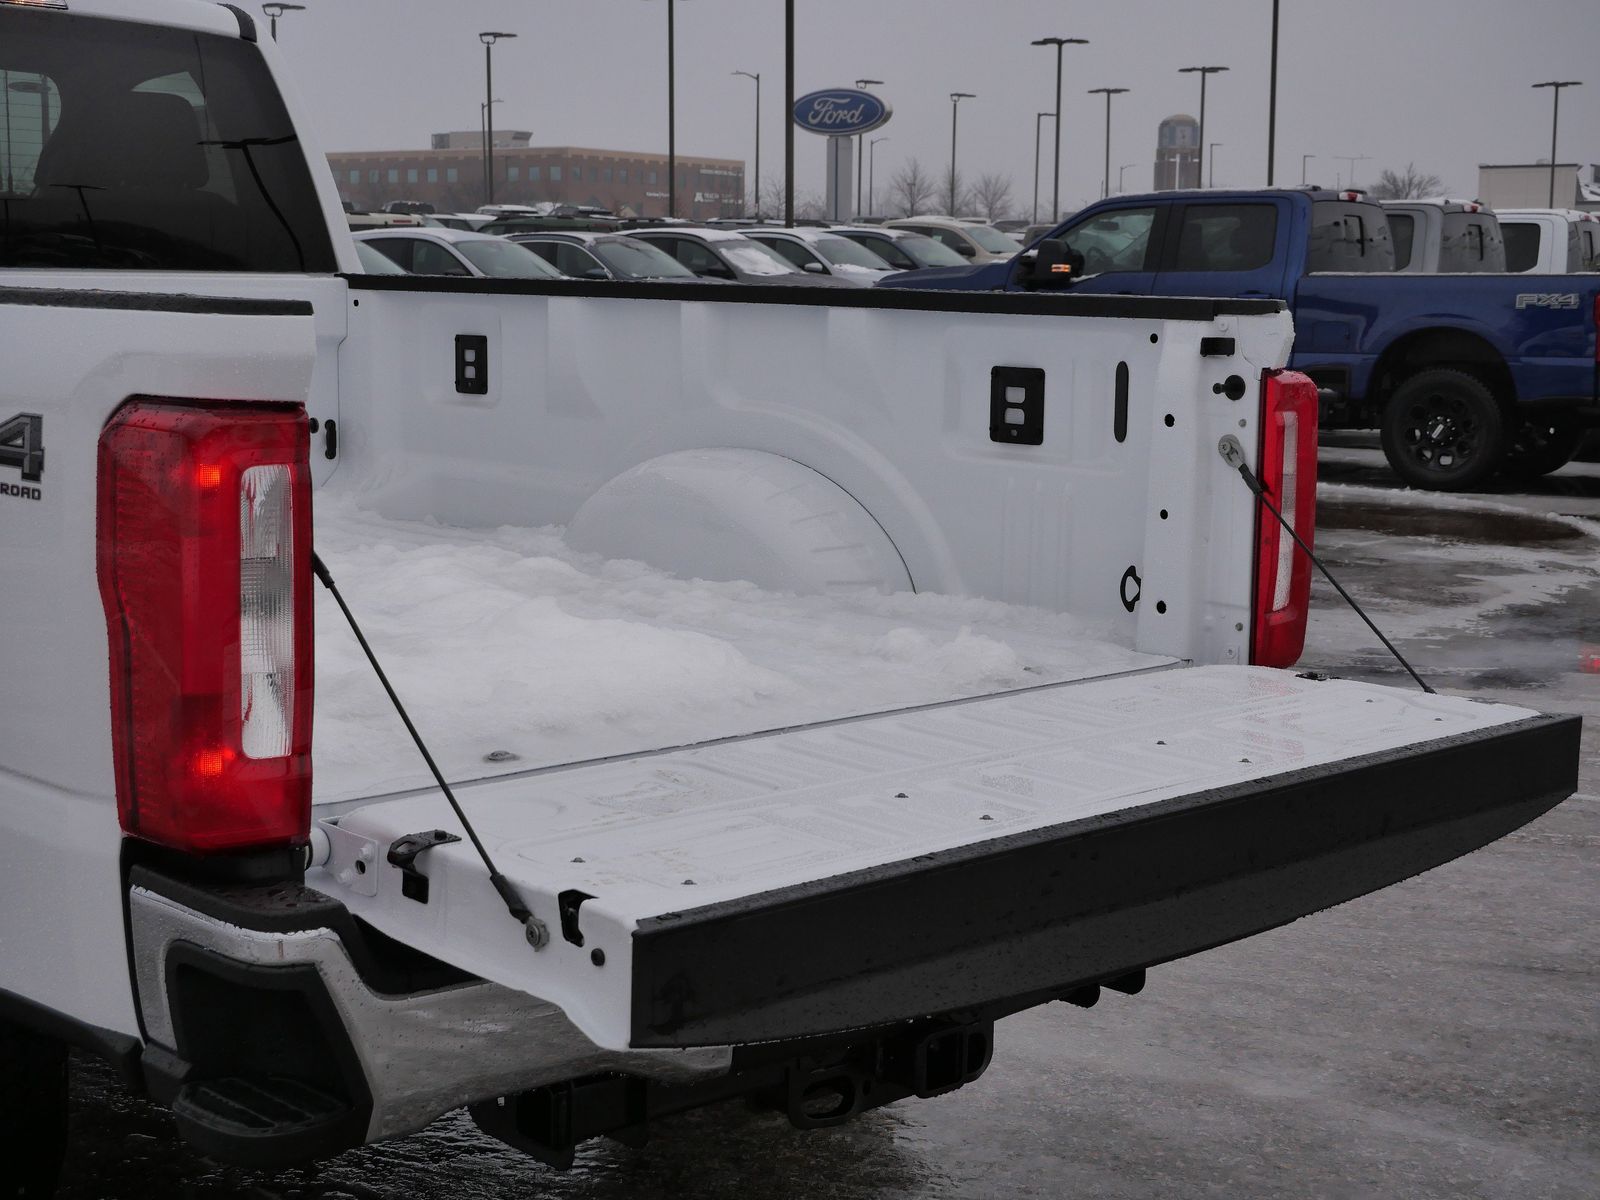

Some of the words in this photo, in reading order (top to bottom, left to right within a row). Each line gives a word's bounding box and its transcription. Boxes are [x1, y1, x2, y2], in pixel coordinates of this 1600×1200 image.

[808, 97, 864, 124] Ford
[1515, 293, 1579, 310] FX4
[0, 411, 45, 484] 4
[0, 482, 42, 501] ROAD
